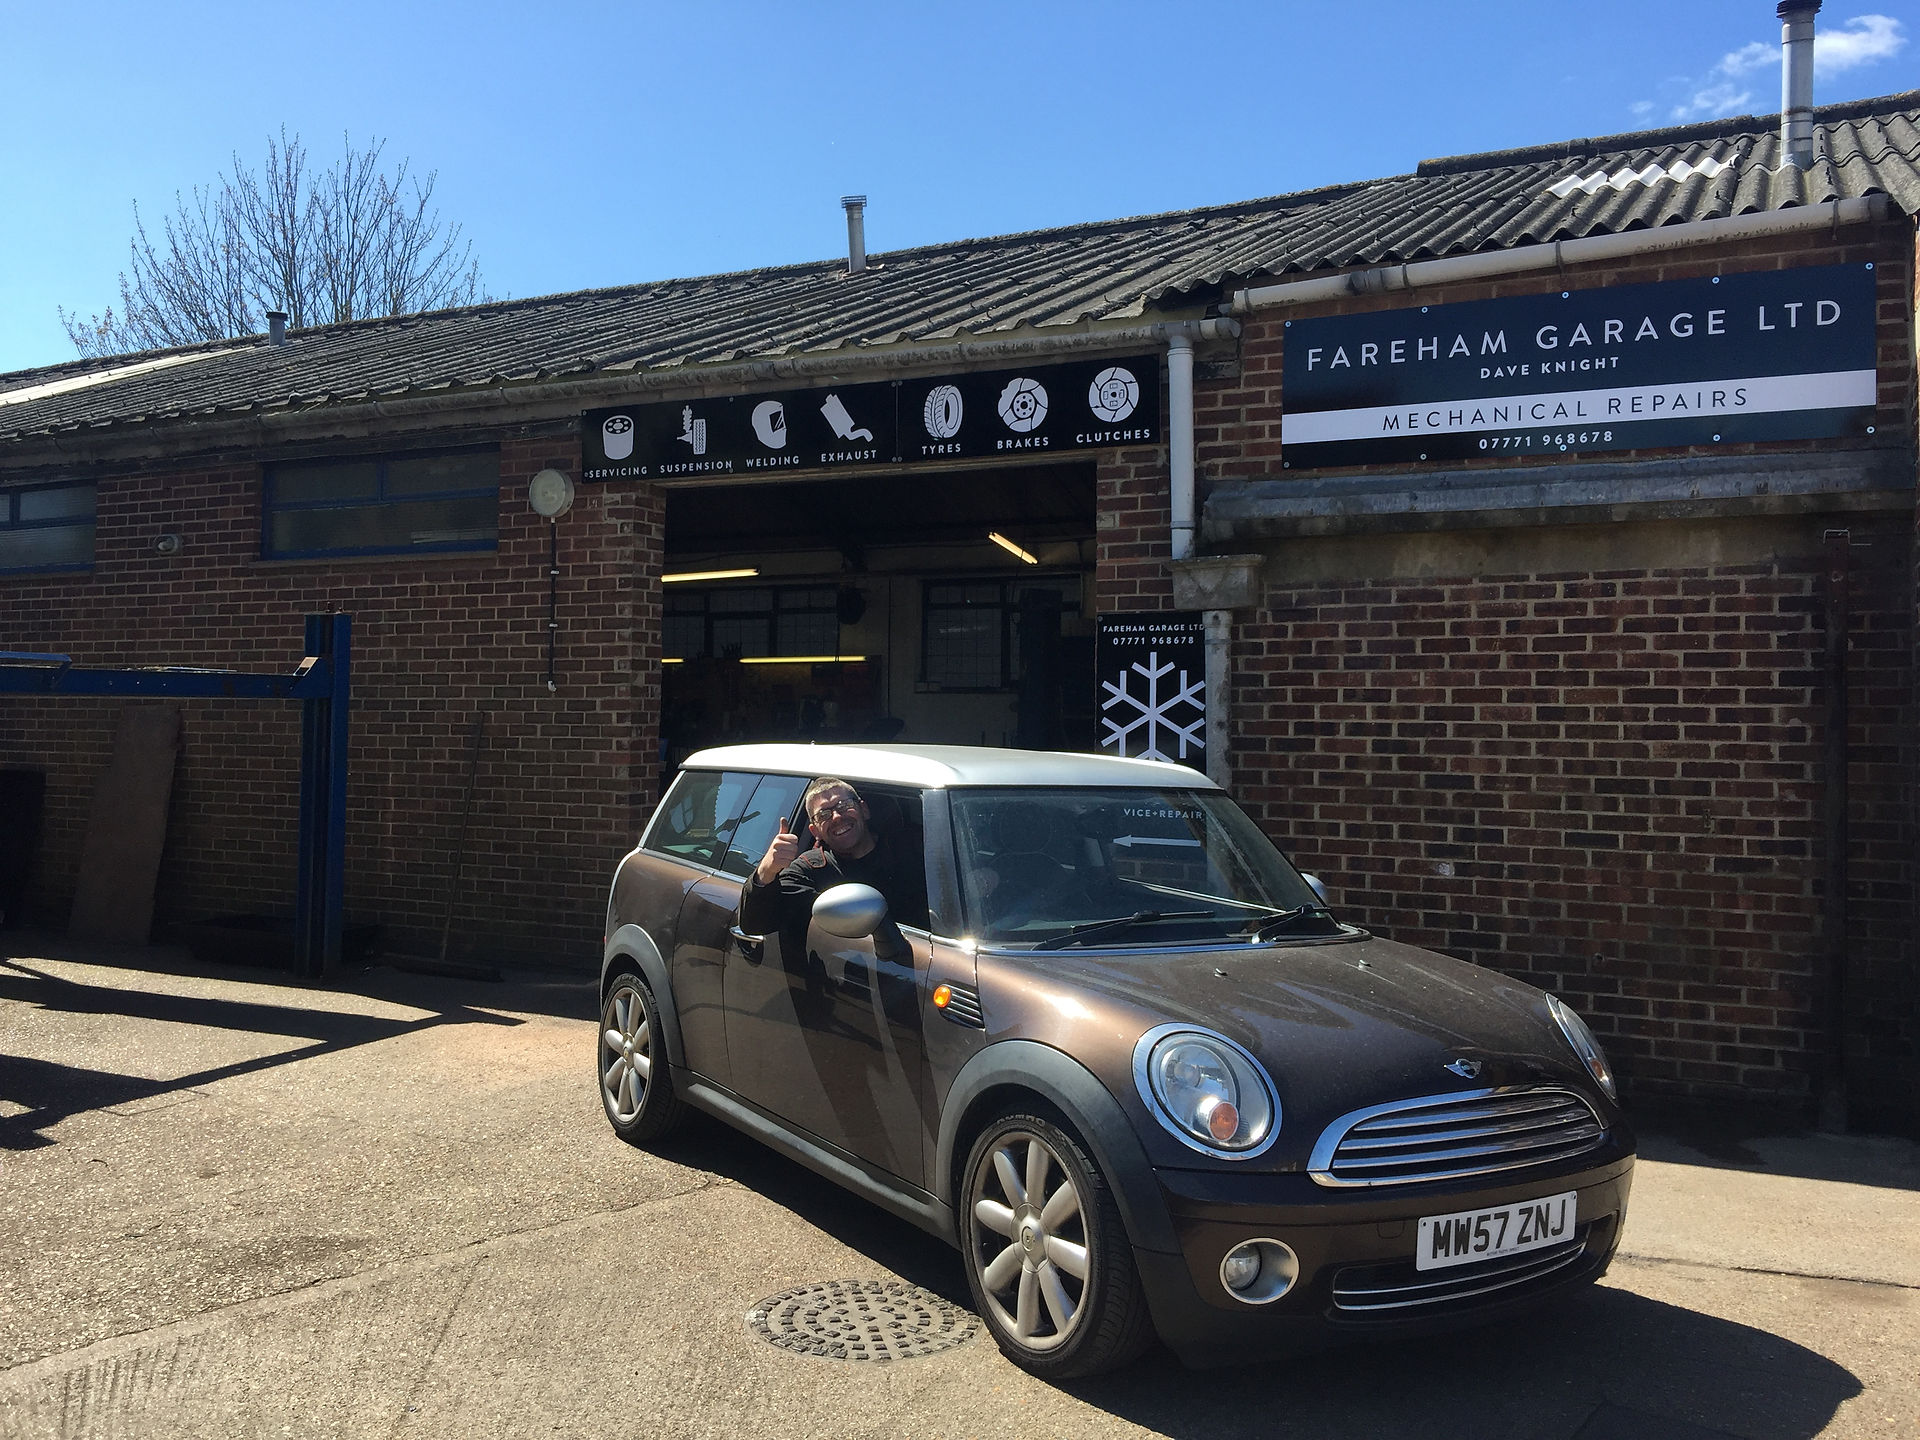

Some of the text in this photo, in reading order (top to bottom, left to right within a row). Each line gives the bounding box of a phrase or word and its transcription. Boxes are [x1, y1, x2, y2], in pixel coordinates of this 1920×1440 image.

[1306, 299, 1843, 372] FAREHAM GARAGE LTD
[1480, 355, 1620, 380] DAVE KNIGHT
[1382, 387, 1749, 432] MECHANICAL REPAIRS
[1076, 428, 1151, 443] CLUTCHES
[1479, 430, 1614, 450] 07771 968678
[922, 443, 962, 455] TYRES
[997, 436, 1049, 449] BRAKES
[746, 455, 800, 468] WELDING
[821, 449, 877, 462] EXHAUST
[589, 466, 648, 479] SERVICING
[659, 460, 733, 474] SUSPENSION
[1103, 623, 1205, 632] FAREHAM GARAGE LTD
[1113, 636, 1194, 645] 07771 968678
[1432, 1199, 1567, 1259] MW57 ZNJ
